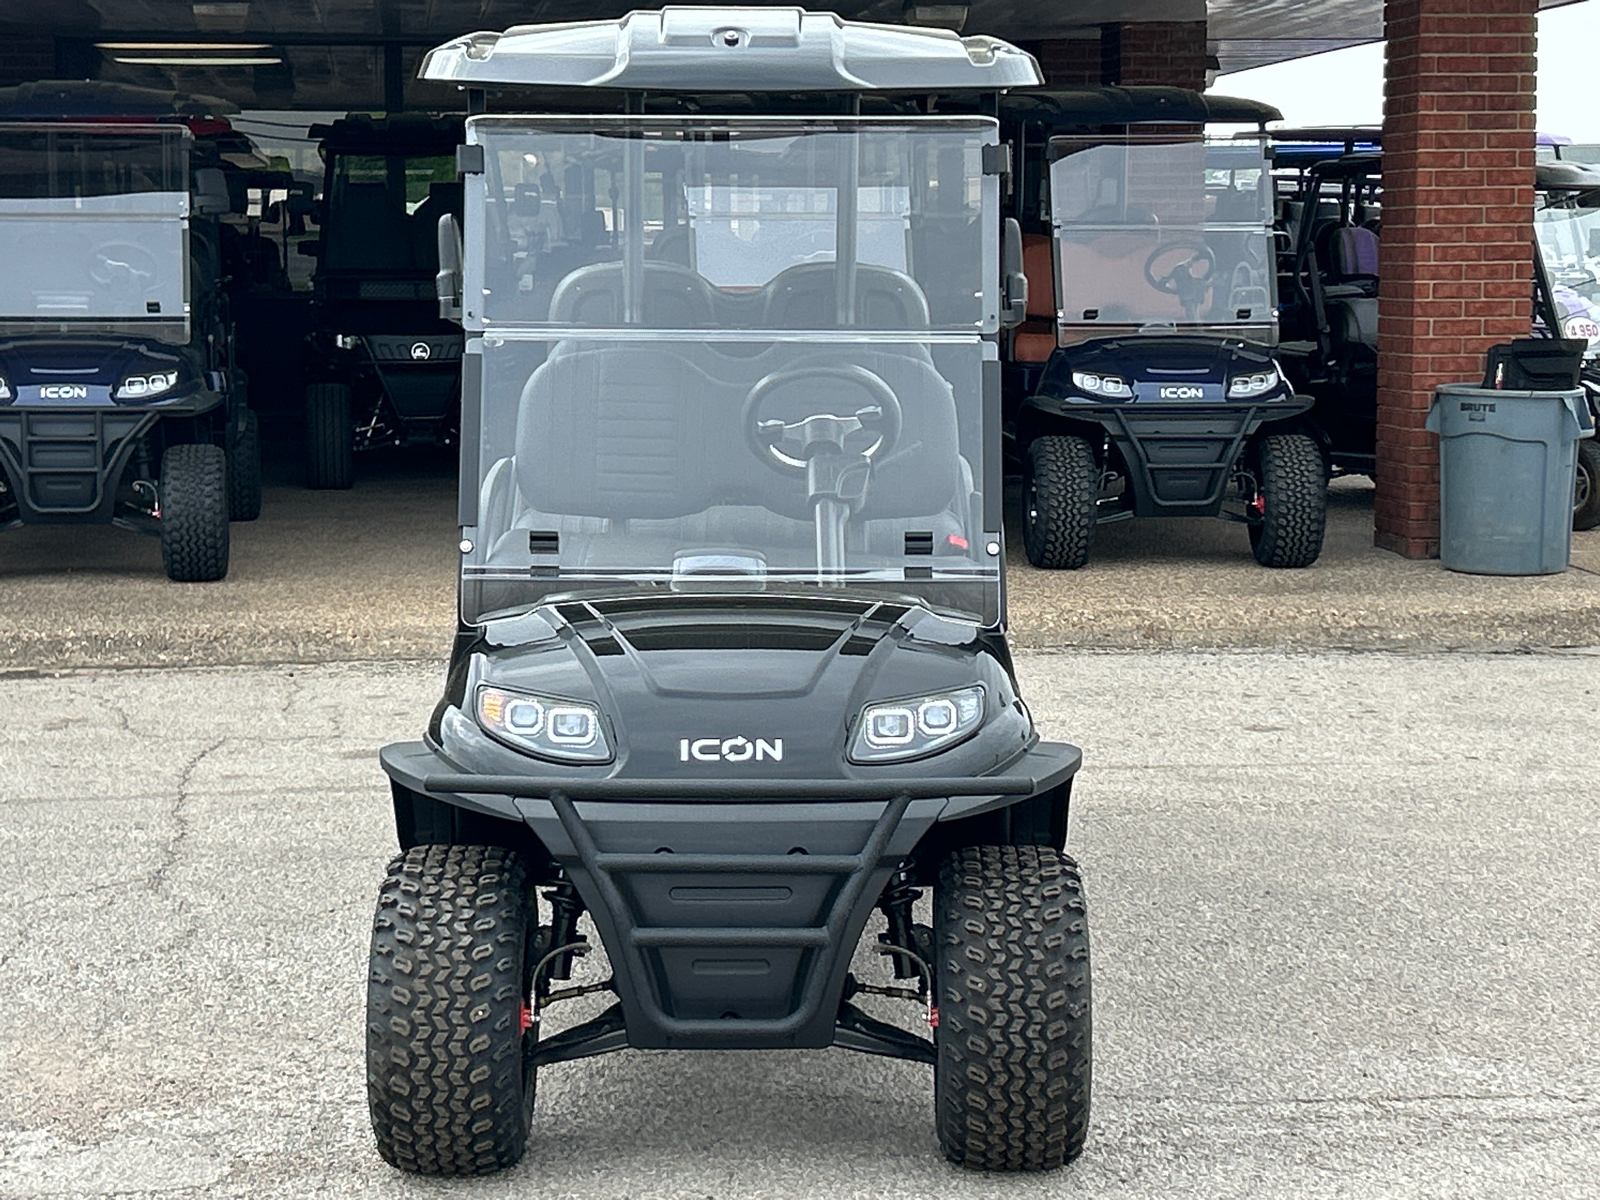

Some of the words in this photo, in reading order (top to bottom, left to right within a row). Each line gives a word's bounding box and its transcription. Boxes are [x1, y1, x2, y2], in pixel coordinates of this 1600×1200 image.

[40, 386, 87, 399] ICON
[1160, 387, 1204, 399] ICON
[1460, 402, 1497, 413] BRUTE
[680, 735, 783, 762] ICON
